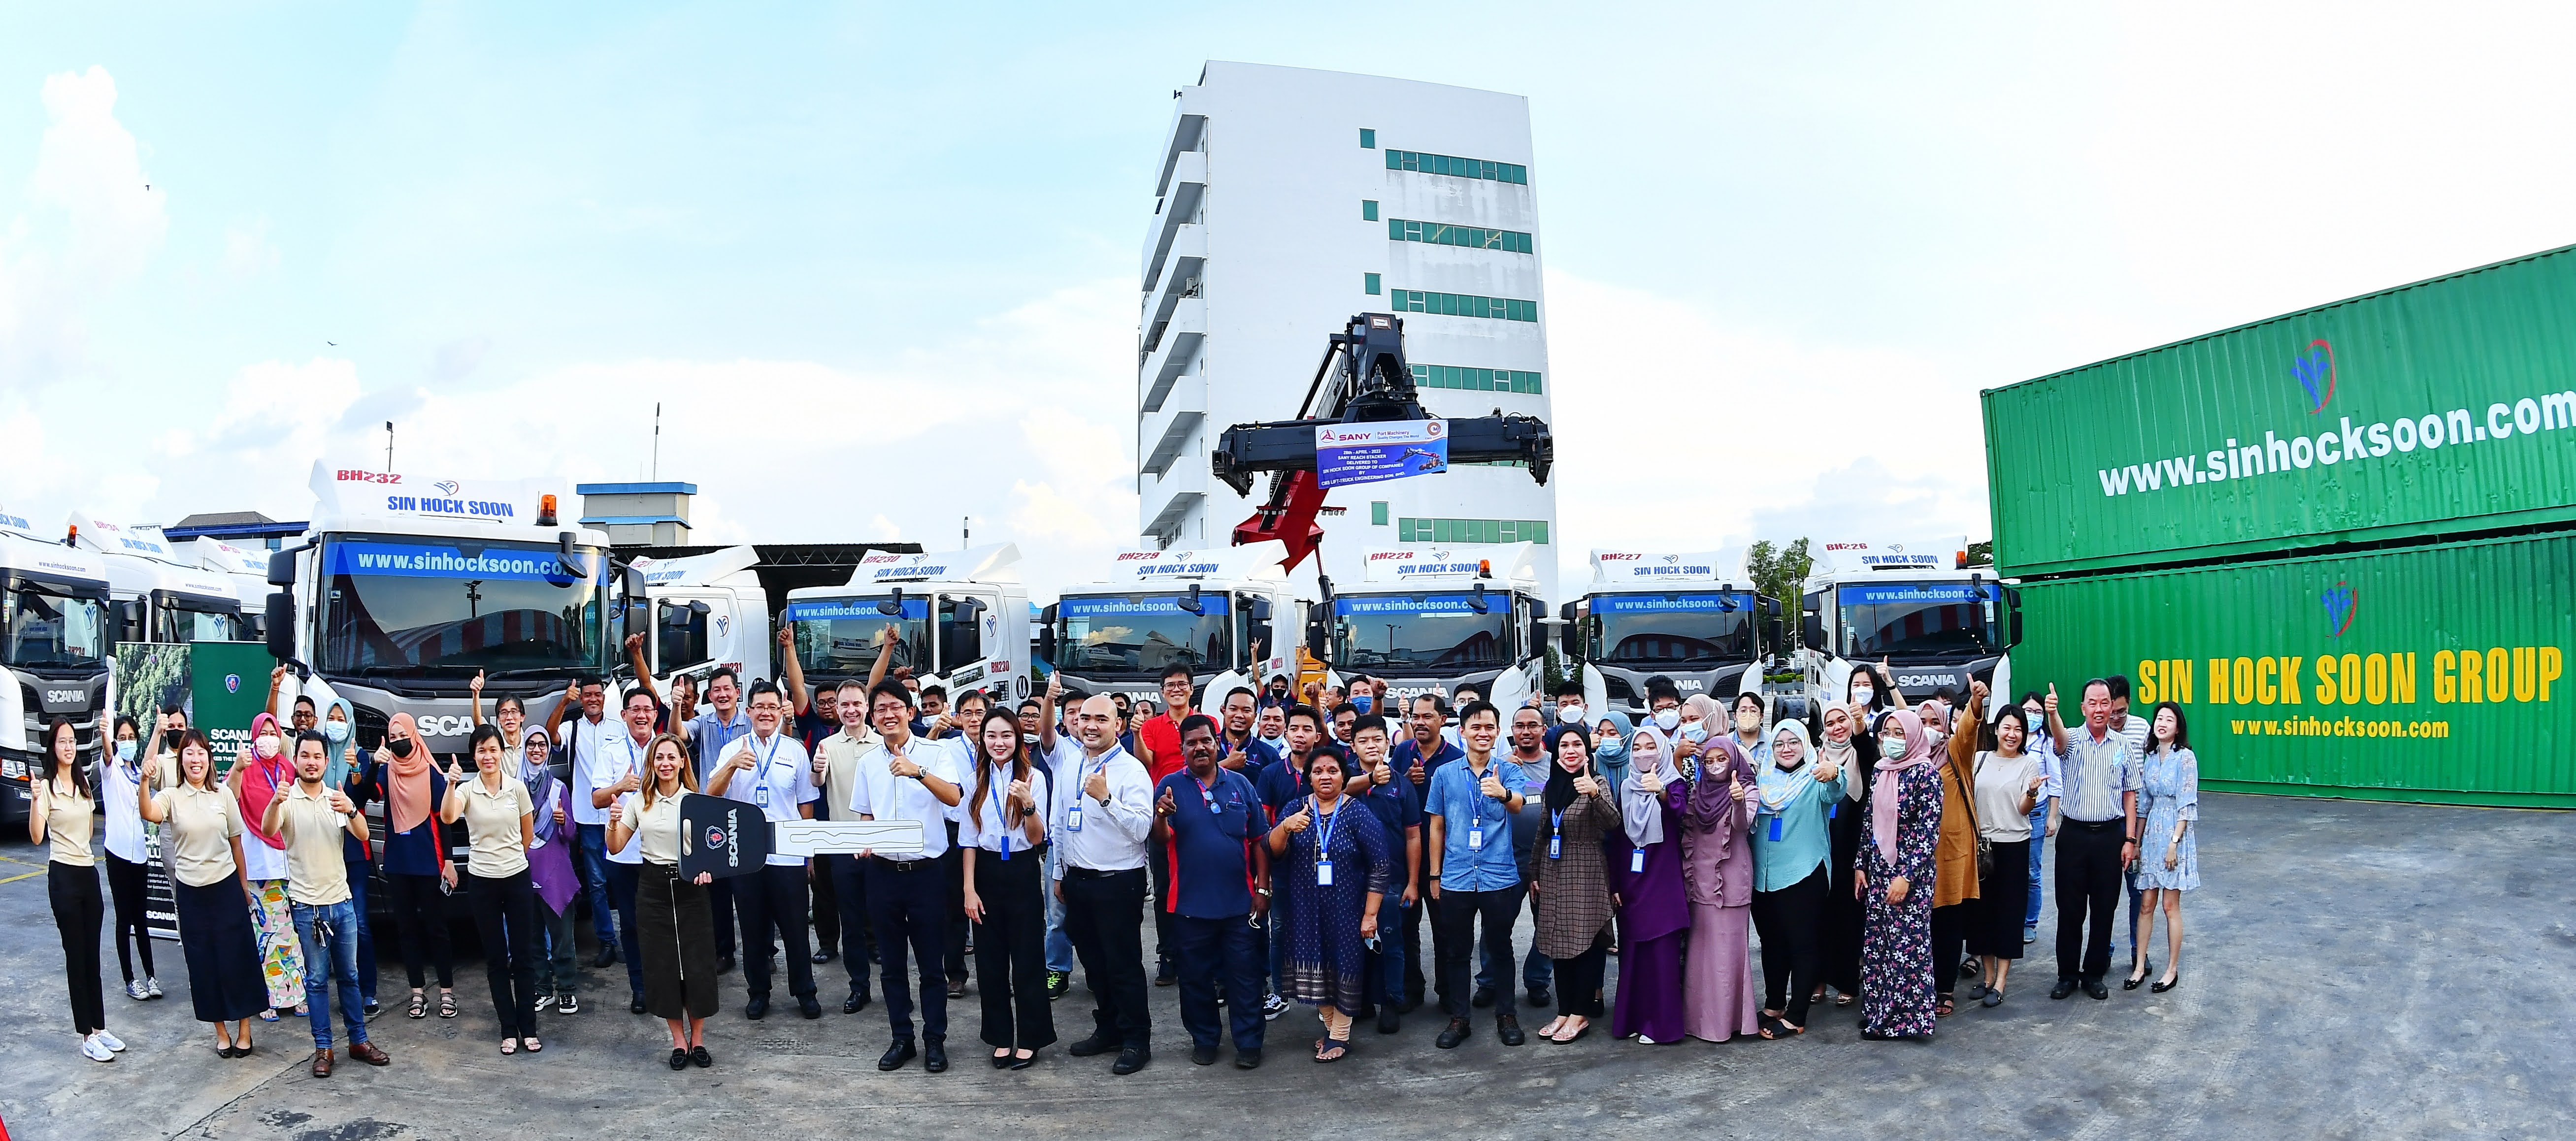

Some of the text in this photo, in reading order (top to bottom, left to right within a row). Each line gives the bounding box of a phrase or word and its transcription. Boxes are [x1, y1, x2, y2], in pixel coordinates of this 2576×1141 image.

[1339, 433, 1371, 441] SANY
[2099, 390, 2576, 497] www.sinhocksoon.com
[337, 470, 402, 484] BH232
[388, 496, 514, 517] SIN HOCK SOON
[10, 516, 31, 530] SOON
[862, 555, 901, 564] BH230
[1117, 552, 1160, 561] BH229
[1370, 552, 1414, 560] BH228
[1862, 554, 1939, 565] SIN HOCK SOON
[38, 561, 86, 572] www.sinhocksoon.com
[358, 551, 571, 576] www.sinhocksoon.co
[1137, 563, 1220, 575] SIN HOCK SOON
[1397, 563, 1480, 574] SIN HOCK SOON
[661, 570, 687, 580] SOON
[874, 565, 948, 578] SIN HOCK SOON
[1634, 566, 1711, 576] SIN HOCK SOON
[1352, 600, 1475, 611] www.sinhocksoon.c
[991, 660, 1010, 673] BH230
[1898, 674, 1957, 687] SCANIA
[2138, 646, 2563, 705] SIN HOCK SOON GROUP
[1018, 677, 1027, 697] KA
[1675, 680, 1703, 690] NIA
[47, 689, 86, 703] SCANIA
[2231, 715, 2449, 739] www.sinhocksoon.com
[727, 808, 739, 868] SCANIA
[146, 910, 176, 921] SCANIA
